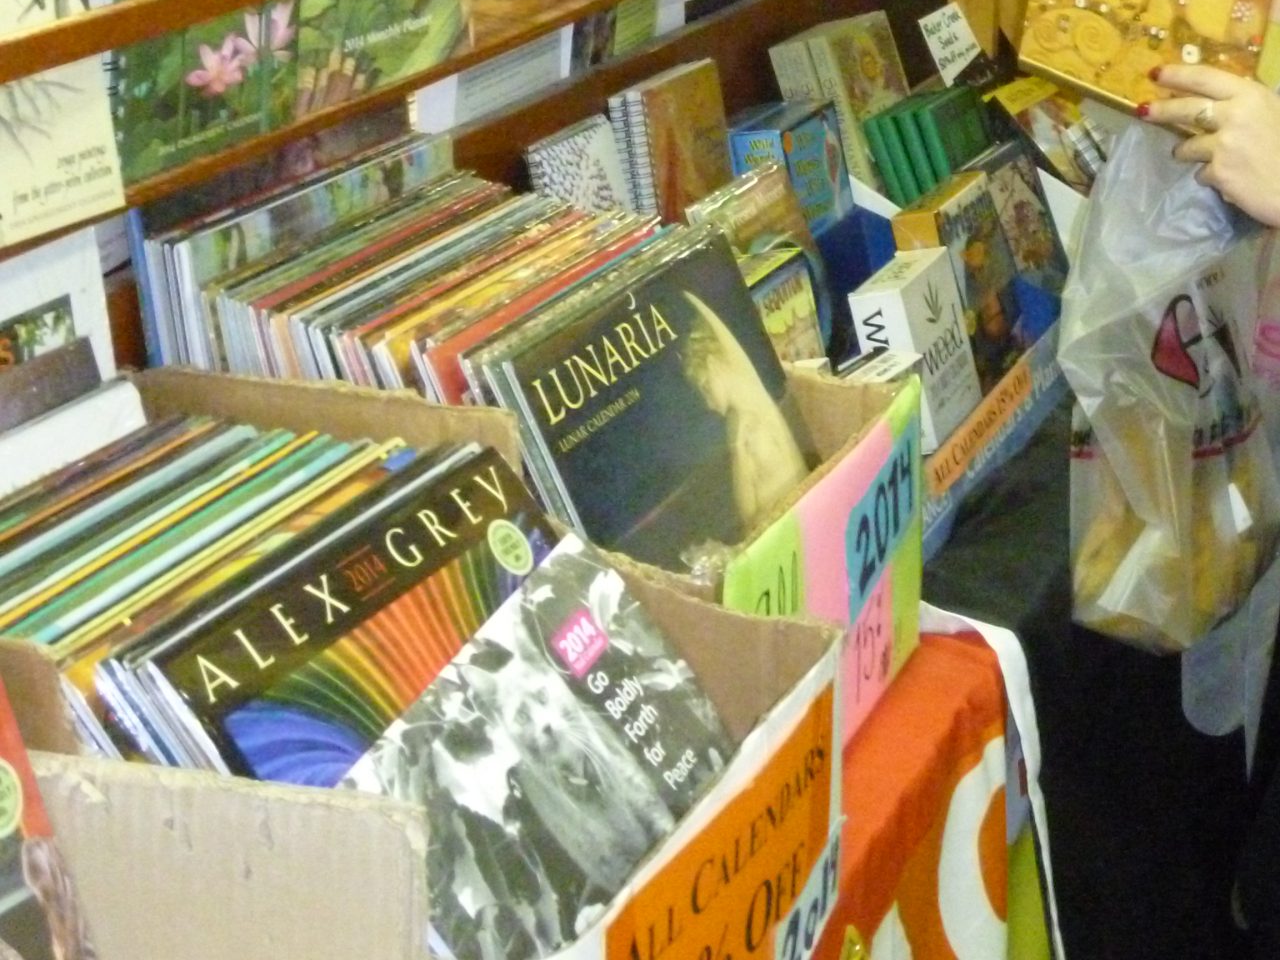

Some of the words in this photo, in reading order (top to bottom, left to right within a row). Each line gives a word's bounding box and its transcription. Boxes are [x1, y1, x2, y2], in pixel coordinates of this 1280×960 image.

[531, 303, 679, 426] LUNARIA
[558, 426, 590, 453] LUNAR
[855, 436, 913, 599] 2014
[196, 573, 351, 704] ALEX
[344, 553, 388, 592] 2014
[385, 465, 509, 568] GREY
[559, 616, 597, 663] 2014
[587, 671, 610, 694] Go
[604, 675, 645, 720] Boldly
[624, 703, 659, 744] Forth
[643, 740, 667, 767] for
[663, 748, 698, 790] Peace
[690, 743, 826, 915] CALENDARS
